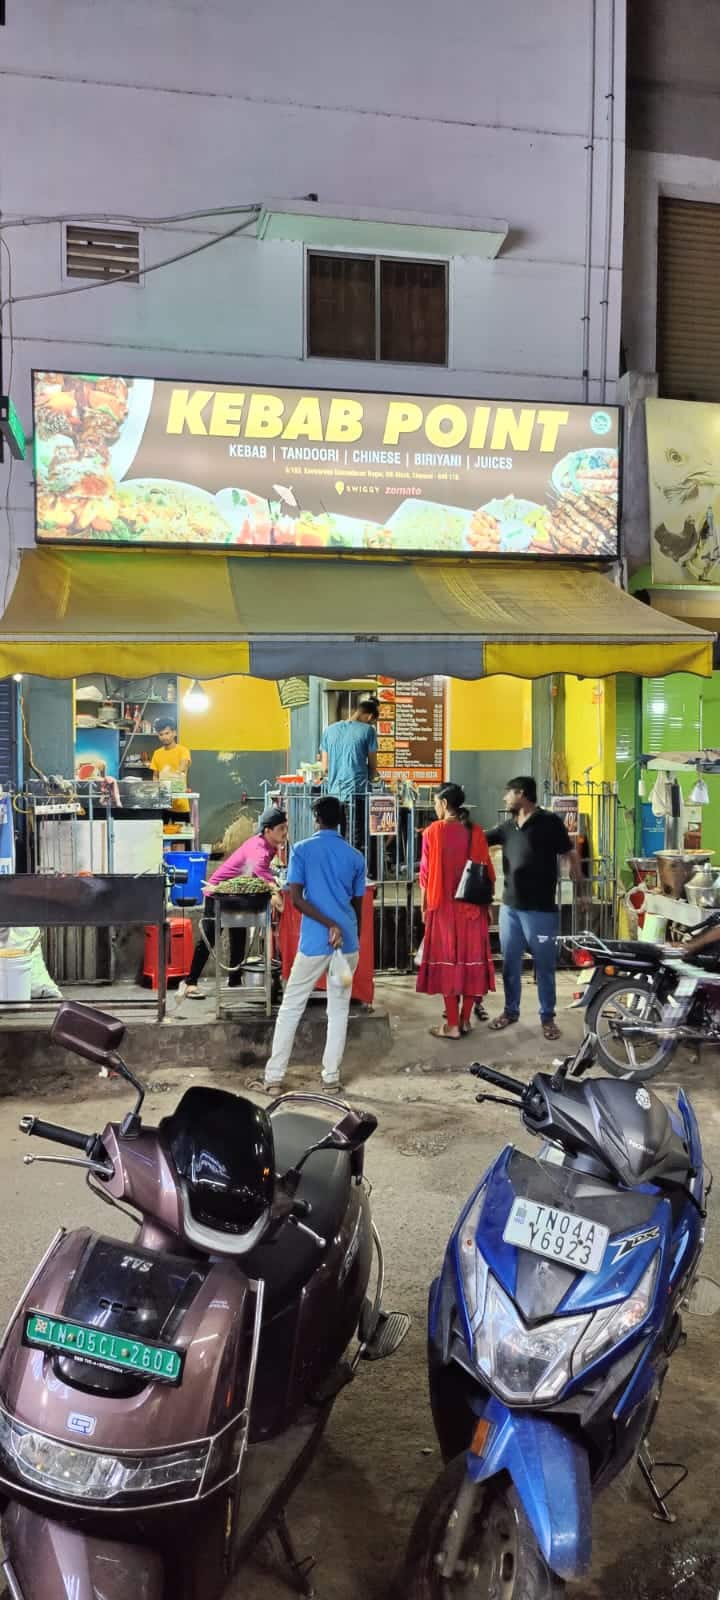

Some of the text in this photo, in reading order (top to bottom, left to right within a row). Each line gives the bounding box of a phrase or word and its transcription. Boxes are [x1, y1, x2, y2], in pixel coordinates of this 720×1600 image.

[166, 389, 569, 452] KEBAB POINT
[229, 443, 513, 469] KEBAB TANDOORI CHINESE BIRIYANI JUICES
[346, 484, 422, 495] SWIGGY zomato
[529, 1222, 592, 1265] Y6923
[533, 1206, 596, 1245] TN04A
[120, 1255, 153, 1273] TVS
[48, 1321, 67, 1343] TN
[76, 1330, 118, 1359] 05CL
[130, 1344, 175, 1376] 2604
